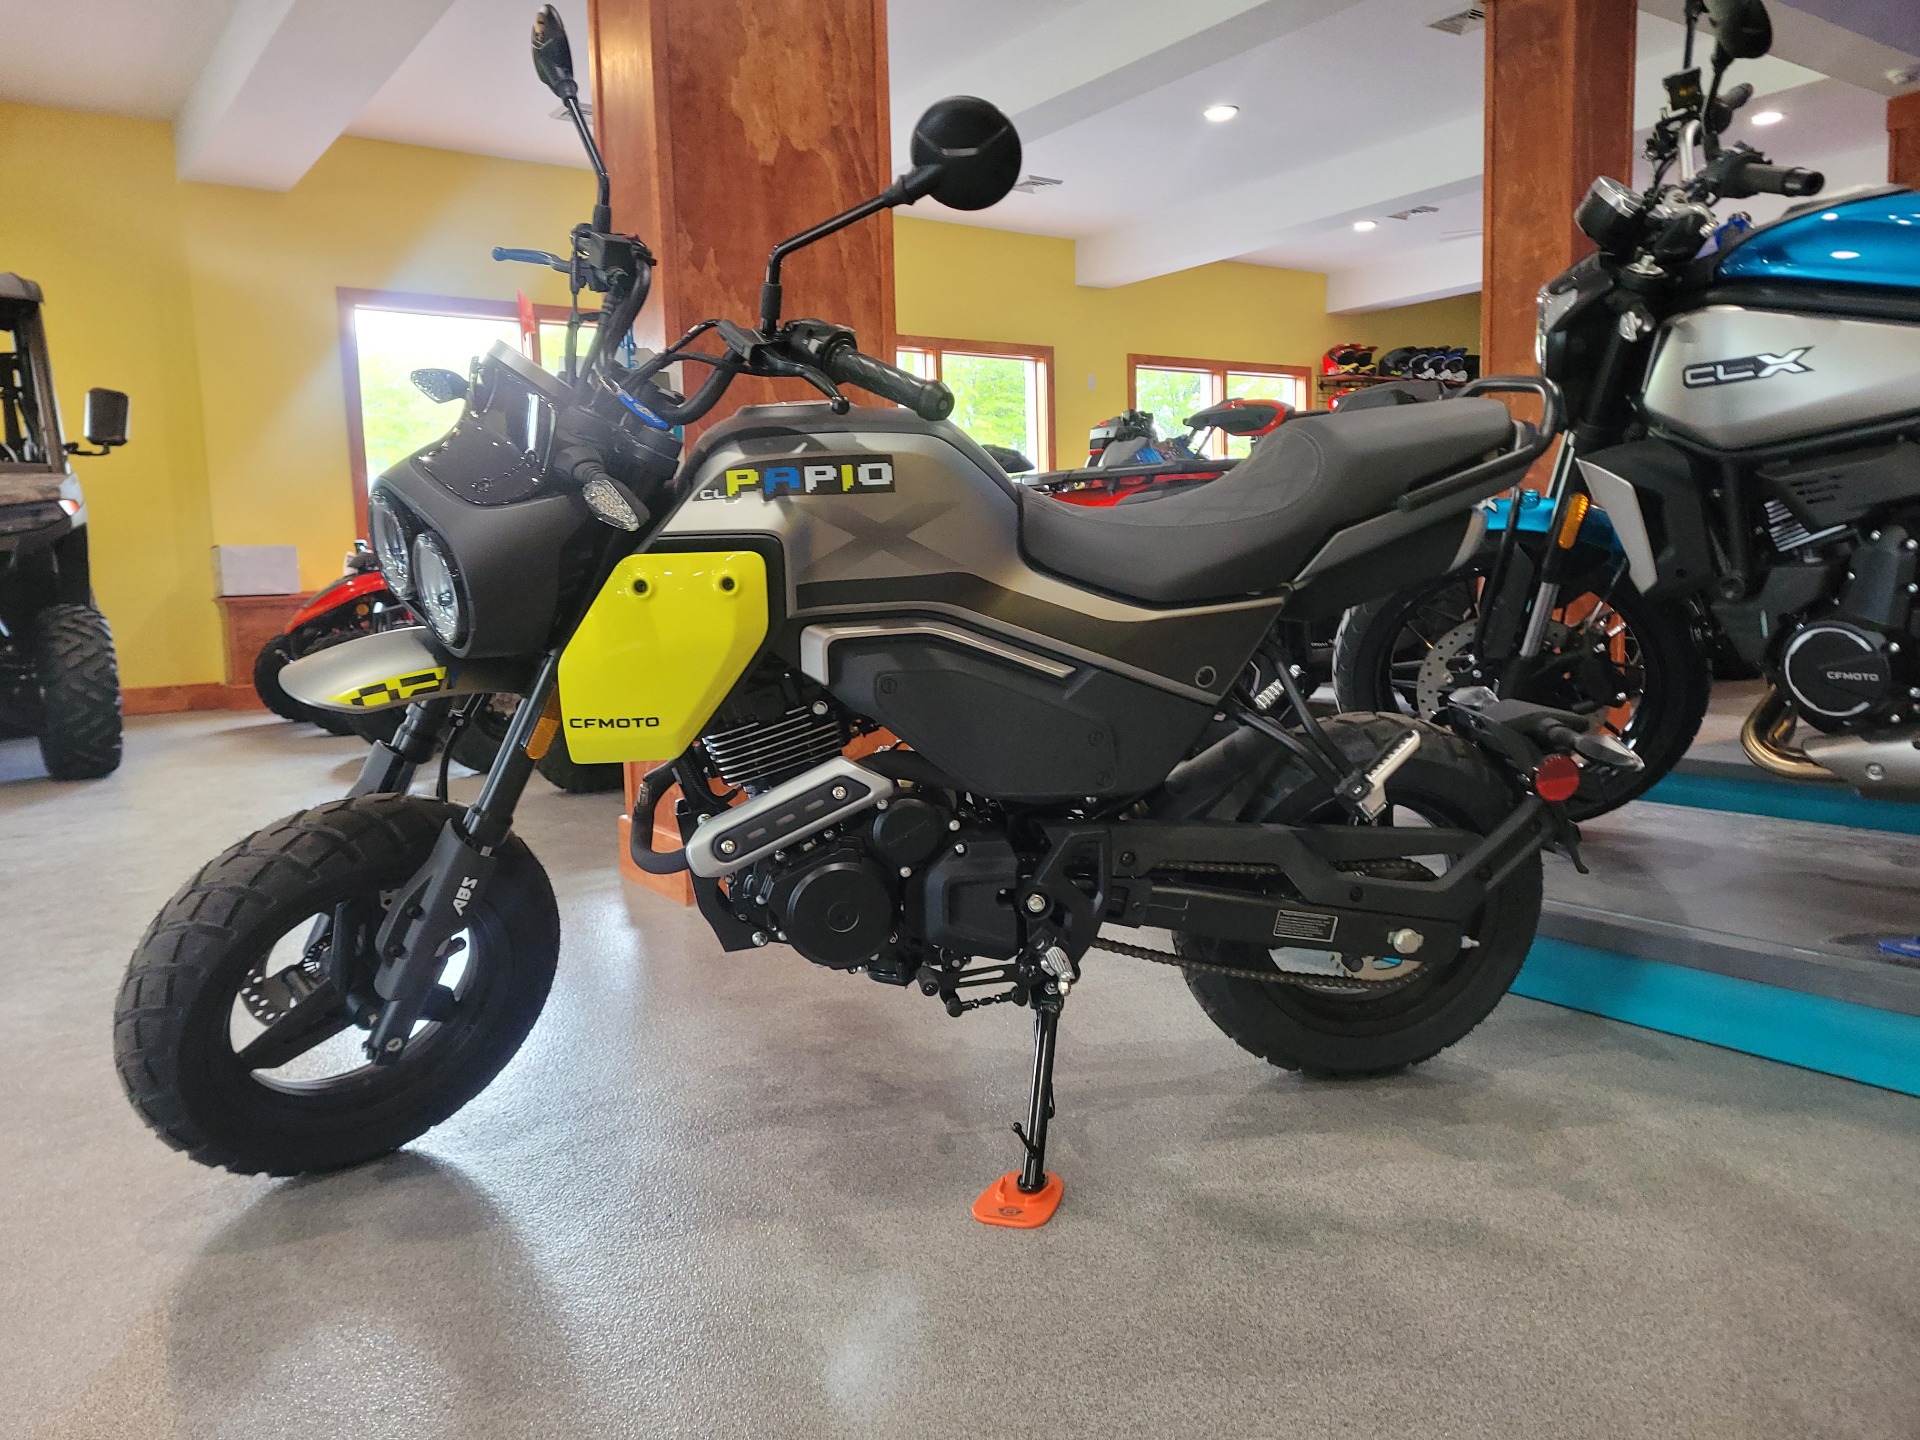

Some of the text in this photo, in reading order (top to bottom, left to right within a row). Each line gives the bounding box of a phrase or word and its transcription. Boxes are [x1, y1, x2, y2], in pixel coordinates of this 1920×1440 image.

[725, 462, 894, 498] PAPIO
[1826, 671, 1879, 681] CFMOTO
[569, 716, 660, 729] CFMOTO
[452, 876, 478, 917] ABS
